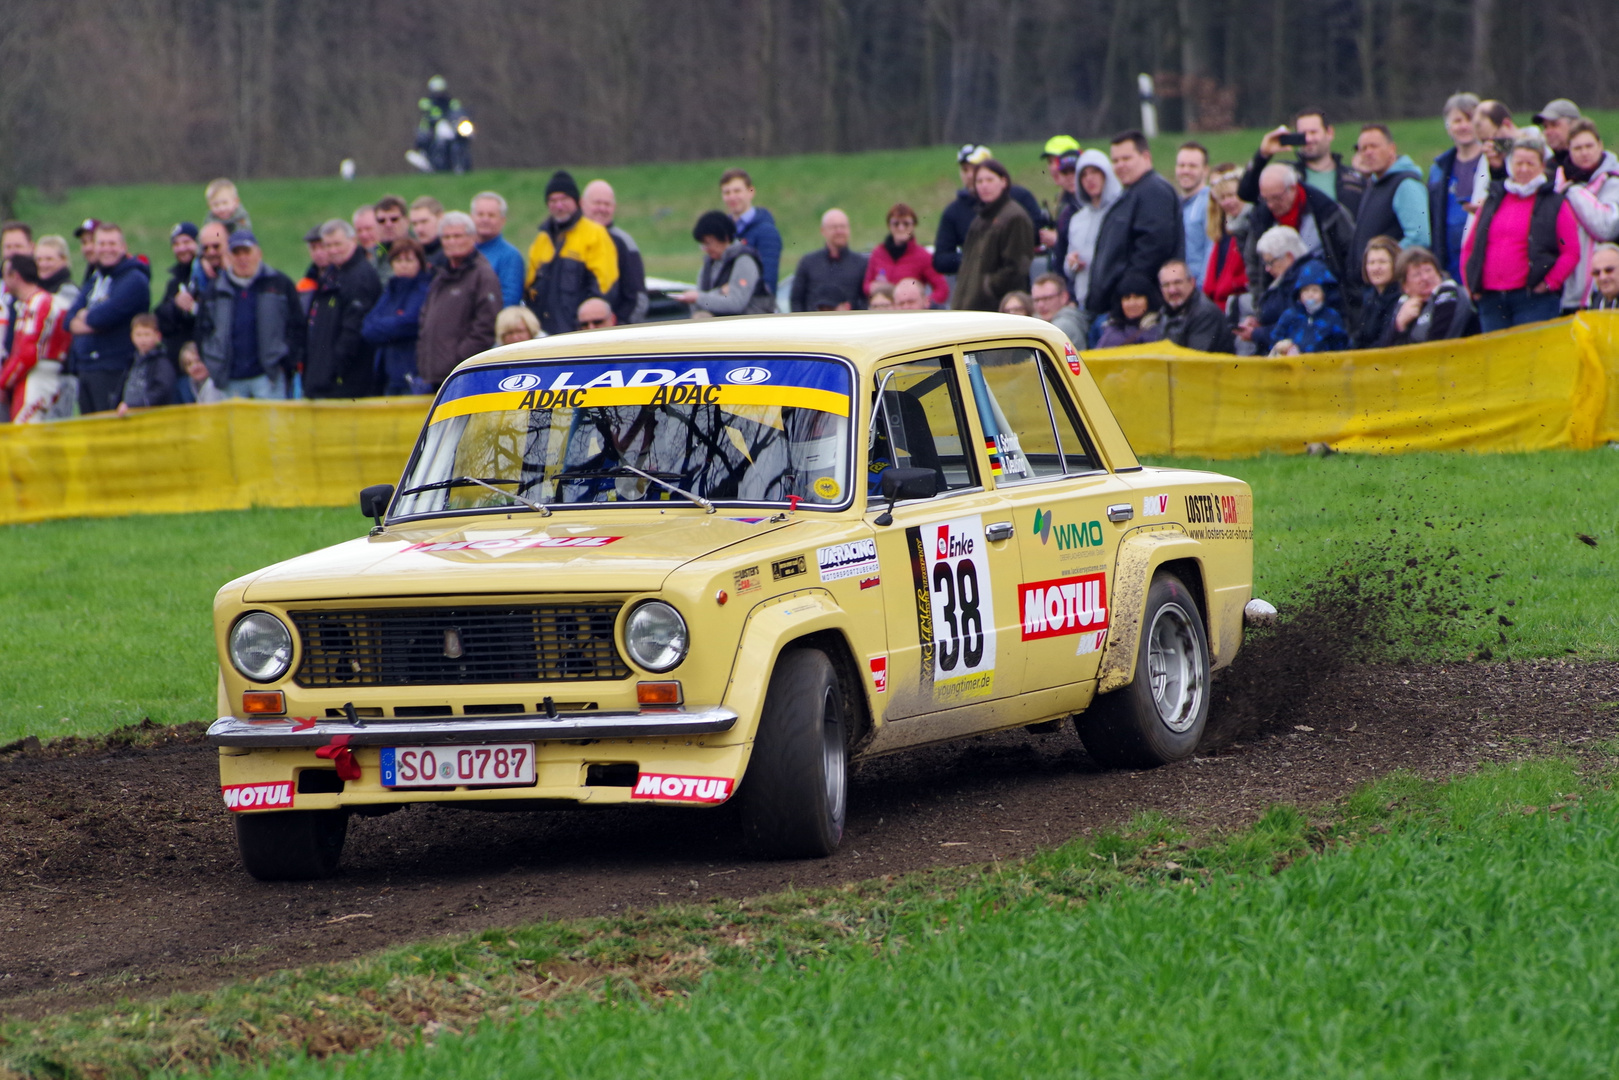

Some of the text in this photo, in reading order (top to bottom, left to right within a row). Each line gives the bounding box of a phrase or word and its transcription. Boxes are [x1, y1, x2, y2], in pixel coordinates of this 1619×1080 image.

[548, 367, 711, 391] LADA
[518, 387, 587, 409] ADAC
[650, 384, 722, 405] ADAC
[949, 532, 974, 558] Enke
[1052, 520, 1104, 550] WMO
[933, 558, 984, 672] 38
[1024, 579, 1106, 634] MOTUL
[385, 748, 527, 781] D SO 0787
[223, 784, 291, 808] MOTUL
[634, 775, 728, 799] MOTUL
